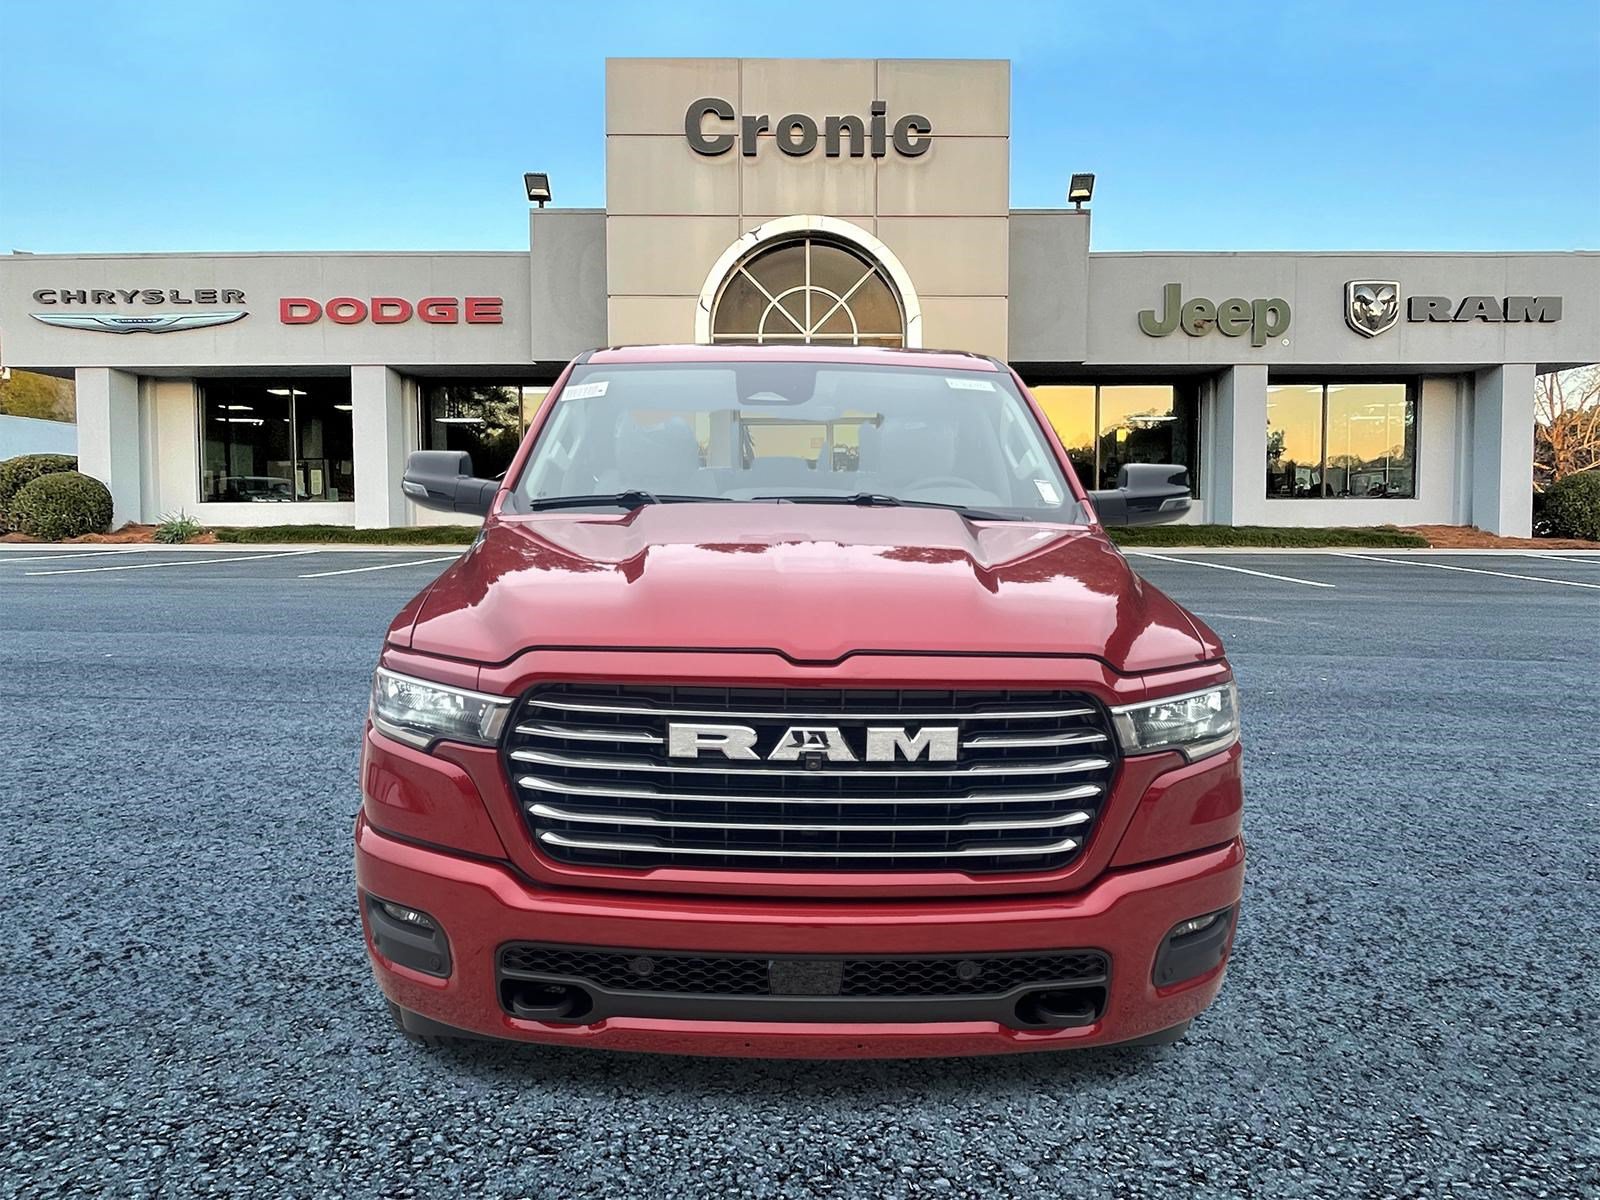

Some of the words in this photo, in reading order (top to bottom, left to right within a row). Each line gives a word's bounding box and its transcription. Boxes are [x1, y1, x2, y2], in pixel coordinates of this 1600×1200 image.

[685, 97, 932, 157] Cronic
[32, 288, 247, 304] CHRYSLER
[280, 297, 503, 324] DODGE
[1407, 296, 1563, 322] RAM
[1138, 283, 1292, 346] Jeep
[668, 722, 959, 762] RAM
